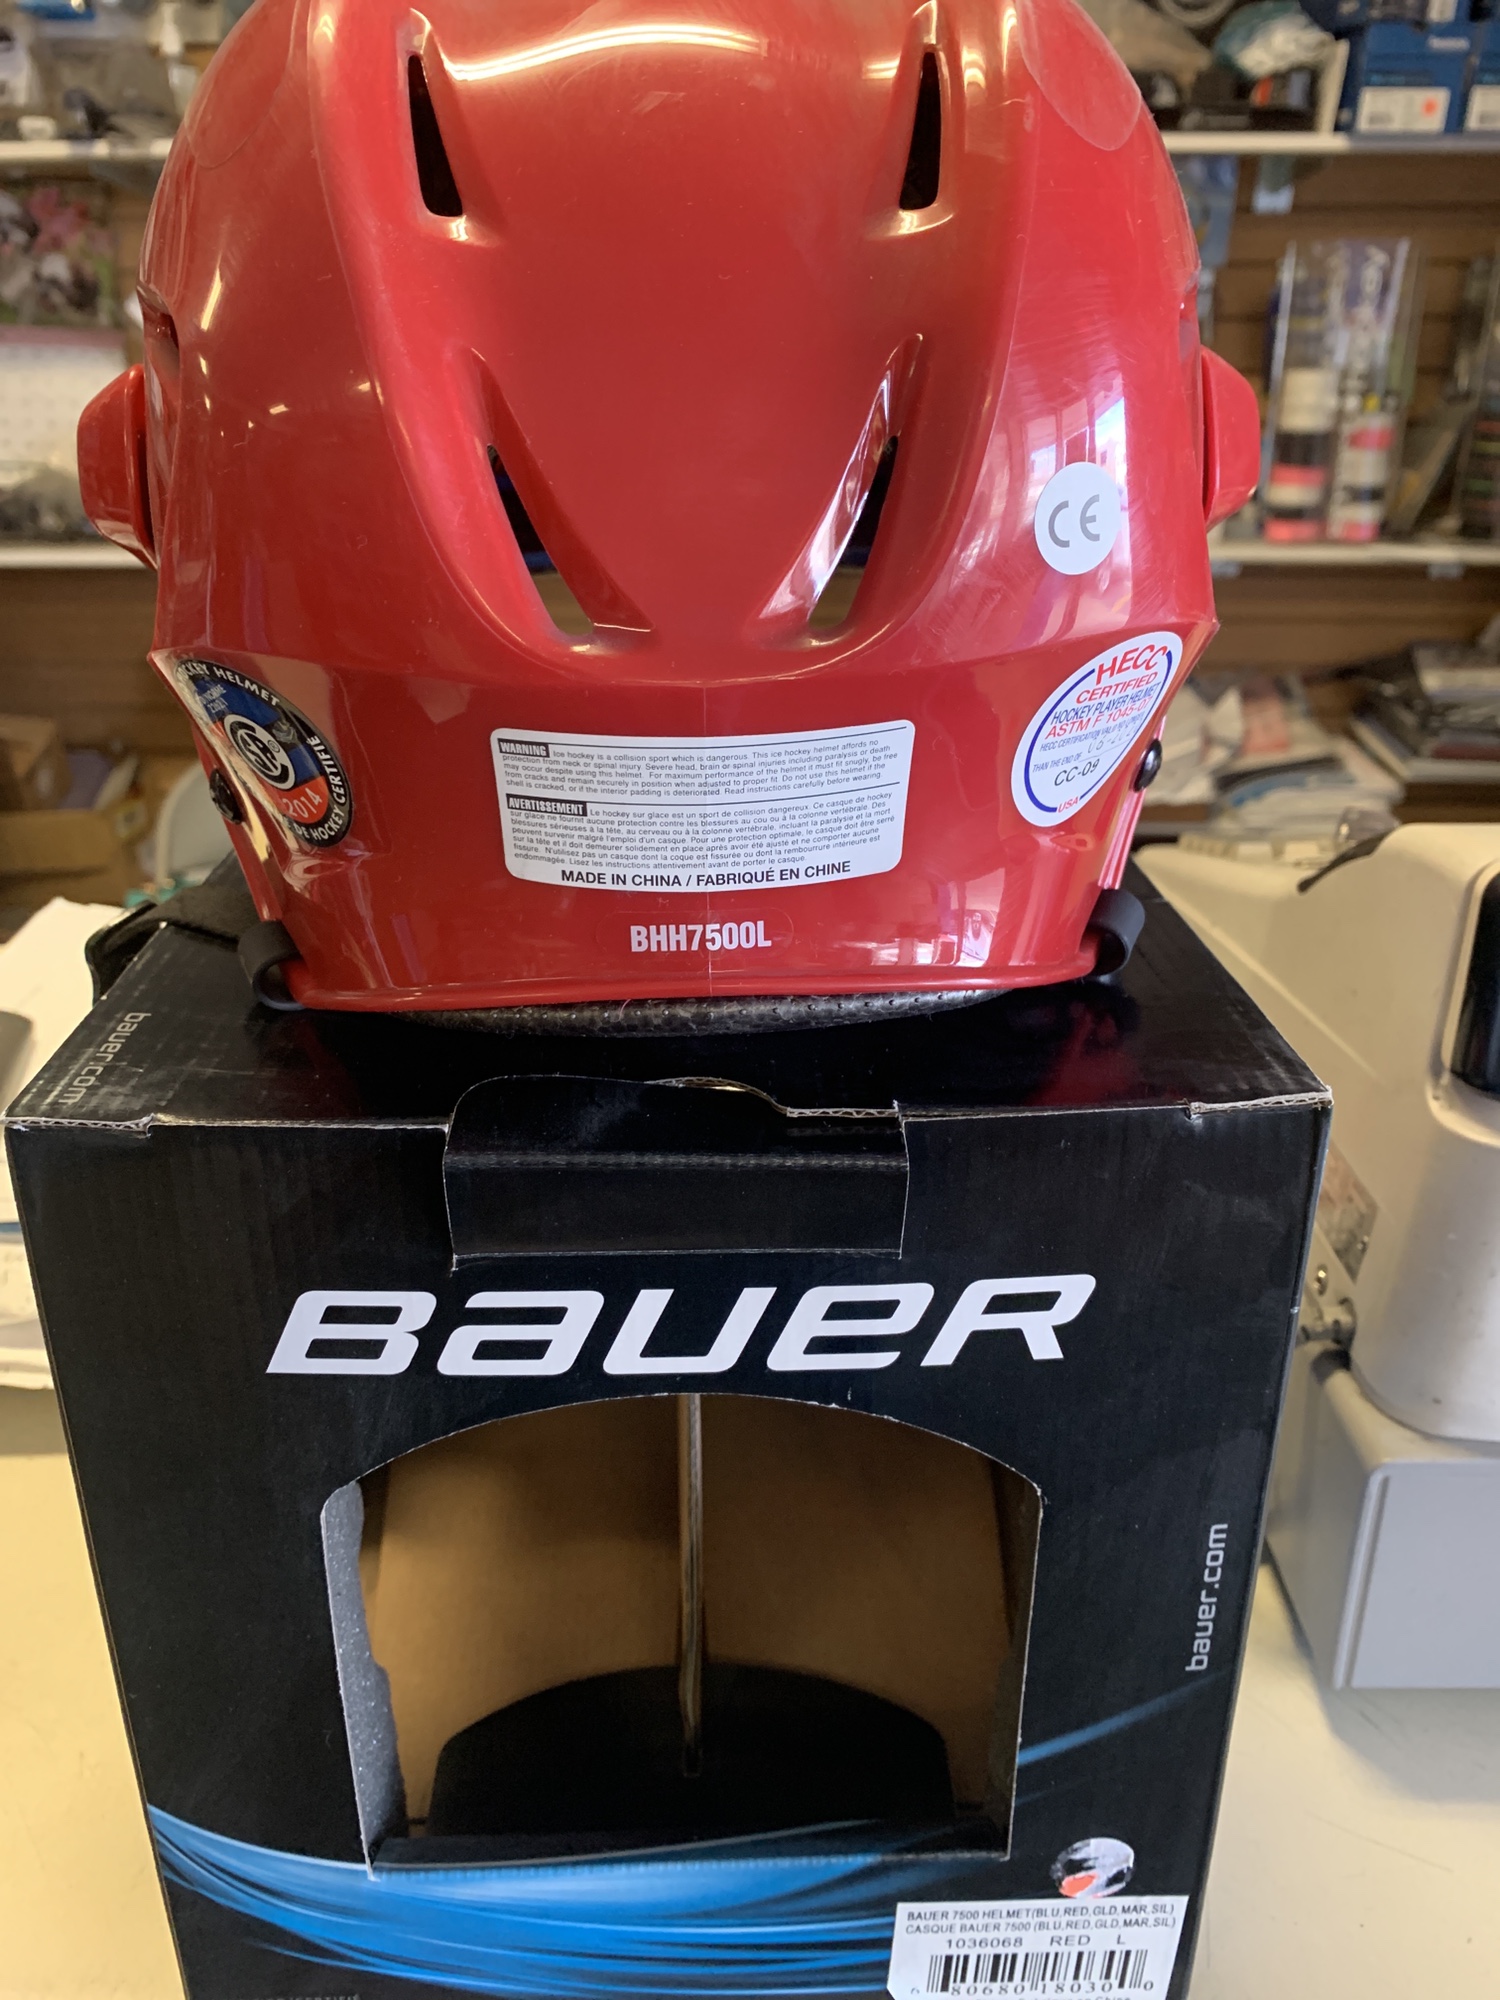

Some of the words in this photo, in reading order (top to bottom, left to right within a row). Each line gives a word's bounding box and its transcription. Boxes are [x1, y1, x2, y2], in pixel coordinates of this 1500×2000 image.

[1048, 494, 1100, 548] CE
[1096, 644, 1168, 685] HECC
[213, 667, 280, 706] HELMET
[1076, 672, 1158, 704] CERTIFIED
[1051, 705, 1093, 725] HOCKEY
[1095, 695, 1128, 716] PLAYER
[1126, 682, 1162, 704] HELMET
[1045, 720, 1090, 740] ASTM
[1092, 715, 1104, 728] F
[1057, 730, 1101, 748] CERTIFICATION
[500, 741, 547, 757] WARNING
[553, 749, 565, 758] Ice
[566, 750, 594, 761] hockey
[613, 753, 646, 761] collision
[648, 754, 669, 763] sport
[671, 754, 694, 762] which
[751, 750, 768, 759] This
[770, 749, 782, 758] ice
[784, 746, 811, 758] hockey
[813, 743, 839, 754] helmet
[841, 739, 866, 750] affords
[502, 752, 540, 765] protection
[542, 756, 560, 765] from
[562, 758, 581, 767] neck
[593, 760, 617, 770] spinal
[644, 762, 673, 770] Severe
[699, 761, 719, 770] brain
[732, 759, 756, 770] spinal
[757, 757, 786, 768] injuries
[788, 753, 822, 766] including
[824, 748, 858, 762] paralysis
[869, 743, 889, 754] death
[504, 763, 519, 772] may
[544, 764, 573, 776] despite
[575, 767, 596, 778] using
[598, 768, 612, 777] this
[648, 770, 662, 778] For
[664, 770, 702, 778] maximum
[704, 768, 754, 779] performance
[765, 766, 778, 775] the
[780, 763, 806, 773] helmet
[814, 760, 833, 770] must
[883, 750, 897, 760] free
[306, 736, 346, 804] CERTIFIÉ
[505, 769, 522, 778] from
[524, 771, 548, 781] cracks
[550, 773, 565, 782] and
[567, 774, 594, 784] remain
[596, 776, 629, 787] securely
[640, 778, 672, 788] position
[674, 778, 695, 786] when
[697, 777, 731, 788] adjusted
[742, 777, 768, 786] proper
[794, 771, 807, 780] not
[824, 767, 838, 777] this
[840, 763, 865, 775] helmet
[873, 760, 885, 770] the
[1033, 763, 1048, 773] THAN
[1049, 759, 1061, 769] THE
[1054, 758, 1100, 786] CC-09
[506, 777, 523, 787] shell
[585, 784, 598, 793] the
[600, 785, 627, 794] interior
[629, 786, 661, 796] padding
[724, 785, 744, 794] Read
[746, 781, 791, 792] instructions
[792, 777, 824, 790] carefully
[826, 774, 850, 785] before
[282, 788, 322, 818] 2014
[509, 797, 584, 815] AVERTISSEMENT
[602, 808, 630, 819] hockey
[647, 810, 669, 820] glace
[698, 809, 719, 819] sport
[733, 806, 765, 816] collision
[825, 797, 853, 809] casque
[866, 789, 891, 803] hockey
[1058, 796, 1079, 812] USA
[312, 806, 345, 840] HOCKEY
[561, 870, 606, 885] MADE
[612, 874, 627, 885] IN
[632, 874, 682, 887] CHINA
[696, 868, 774, 886] FABRIQUÉ
[780, 868, 800, 881] EN
[804, 861, 851, 878] CHINE
[630, 920, 772, 952] BHH7500L
[58, 1012, 152, 1103] bauer.com
[1185, 1524, 1228, 1671] bauer.com
[906, 1924, 956, 1934] CASQUE
[960, 1923, 1000, 1933] BAUER
[1005, 1922, 1030, 1931] 7500
[907, 1911, 949, 1921] BAUER
[953, 1910, 979, 1920] 7500
[947, 1937, 1023, 1949] 1036068
[1050, 1934, 1091, 1946] RED
[1116, 1934, 1126, 1945] L
